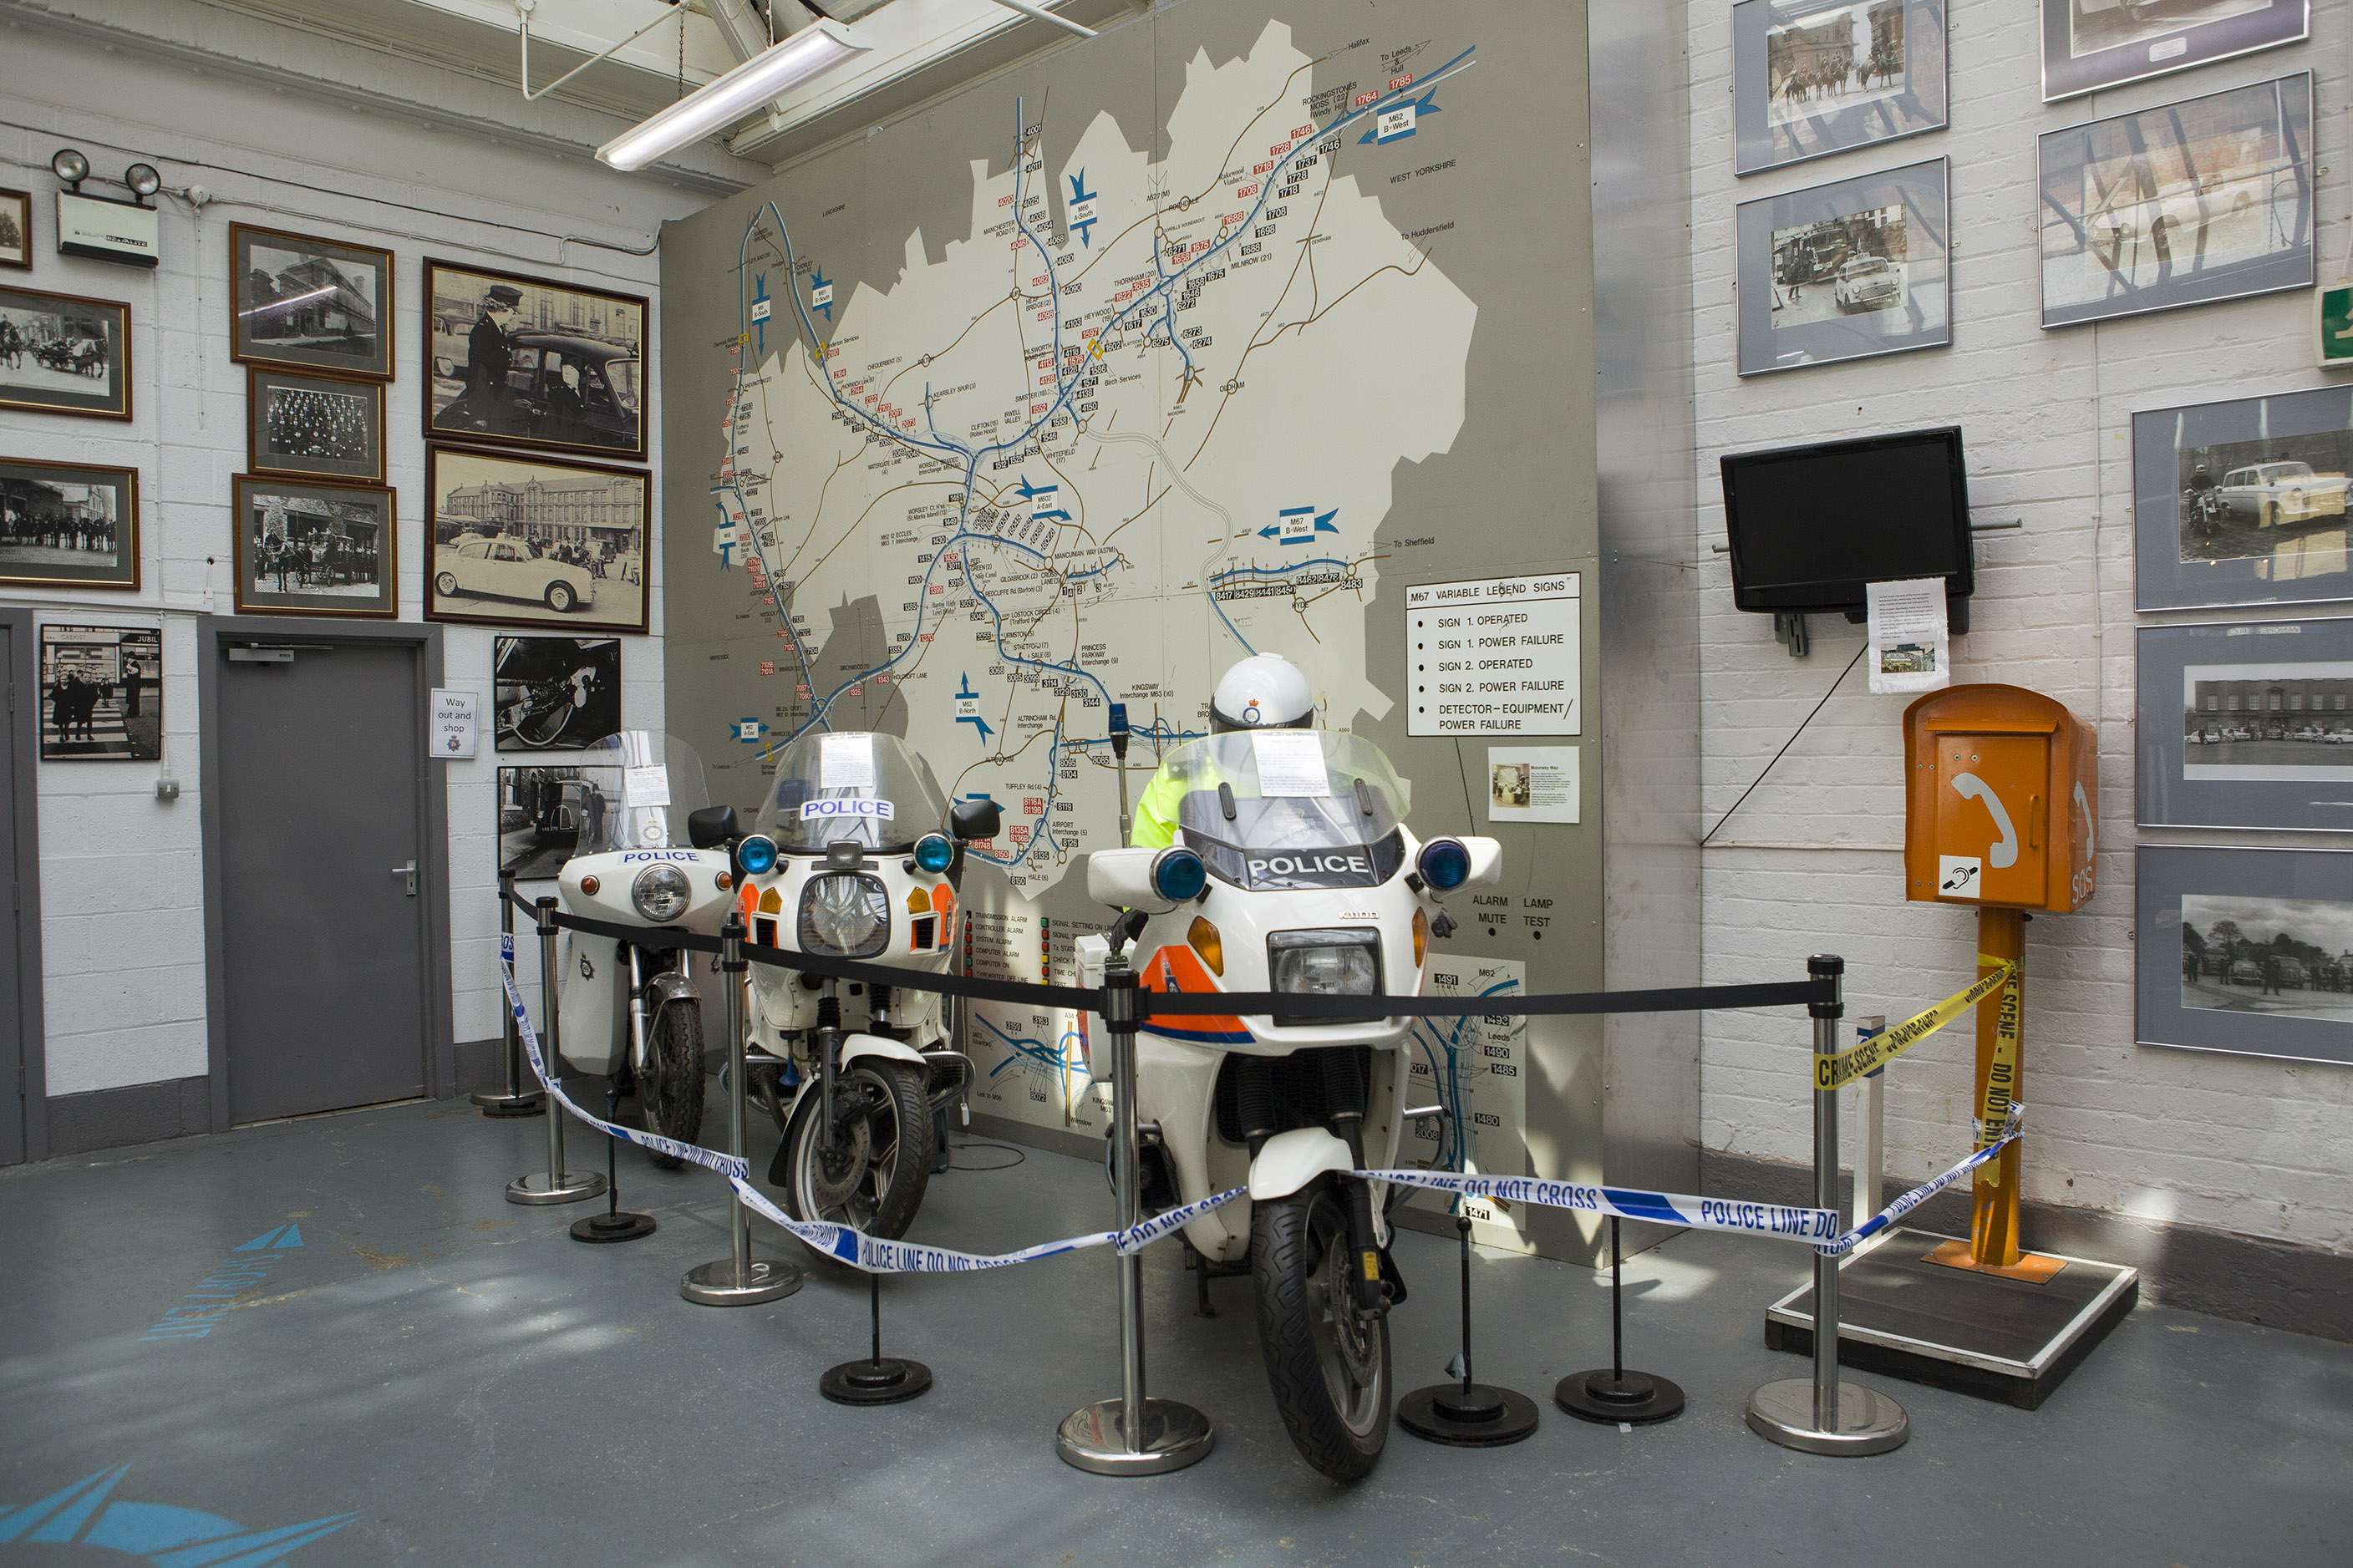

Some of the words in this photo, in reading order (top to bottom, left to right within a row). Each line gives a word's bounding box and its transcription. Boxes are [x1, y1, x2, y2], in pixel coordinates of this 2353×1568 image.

[1348, 38, 1370, 50] Halifax
[1392, 46, 1411, 58] Leeds
[1391, 65, 1404, 74] Hull
[1303, 82, 1357, 106] ROCKINGSTONES
[1357, 92, 1377, 104] 1764
[1310, 99, 1331, 111] MOSS
[1334, 93, 1349, 104] (22)
[1310, 107, 1332, 119] (Windy
[1389, 114, 1403, 124] M62
[1026, 124, 1041, 135] 4001
[1320, 141, 1339, 153] 1746
[1297, 157, 1316, 169] 1737
[1390, 174, 1410, 184] WEST
[1415, 160, 1456, 177] YORKSHIRE
[1078, 204, 1089, 212] M66
[1074, 211, 1093, 221] A-South
[1037, 221, 1053, 232] 4054
[1256, 226, 1275, 237] 1698
[1410, 221, 1454, 238] Huddersfield
[1192, 241, 1210, 251] 1675
[1231, 257, 1259, 269] MILNROW
[1261, 253, 1272, 262] (21)
[1114, 273, 1145, 287] THORNHAM
[1145, 270, 1156, 280] (20)
[1085, 308, 1111, 320] HEYWOOD
[1082, 329, 1098, 338] 1597
[1183, 327, 1202, 337] 6273
[1105, 378, 1117, 386] Birch
[1119, 374, 1141, 384] Services
[933, 388, 956, 398] KEARSLEY
[957, 385, 968, 394] SPUR
[1220, 382, 1245, 393] OLDHAM
[994, 461, 1008, 470] 1512
[1036, 501, 1053, 510] A-East
[1286, 525, 1309, 534] B-West
[1405, 537, 1435, 546] Sheffield
[1055, 551, 1084, 560] MANCUNIAN
[1097, 546, 1116, 555] (A57M)
[1341, 580, 1362, 589] 8483
[1217, 591, 1232, 600] 8417
[1410, 592, 1429, 601] M67
[1436, 588, 1479, 600] VARIABLE
[1487, 584, 1527, 596] LEGEND
[1533, 581, 1565, 592] SIGNS
[1438, 618, 1461, 627] SIGN
[1468, 617, 1473, 626] 1.
[1477, 614, 1528, 625] OPERATED
[1439, 640, 1461, 649] SIGN
[1468, 638, 1474, 647] 1.
[1479, 637, 1516, 647] POWER
[1521, 634, 1564, 646] FAILURE
[1439, 662, 1461, 671] SIGN
[1466, 661, 1474, 670] 2.
[1479, 659, 1533, 670] OPERATED
[1439, 683, 1461, 693] SIGN
[1466, 683, 1474, 692] 2.
[1479, 682, 1517, 692] POWER
[1522, 680, 1564, 691] FAILURE
[445, 698, 465, 708] Way
[455, 712, 471, 720] and
[444, 723, 465, 733] shop
[1440, 720, 1476, 729] POWER
[1481, 720, 1522, 729] FAILURE
[1062, 770, 1077, 779] 8104
[805, 800, 890, 817] POLICE
[624, 851, 700, 863] POLICE
[1248, 855, 1370, 877] POLICE
[2072, 865, 2093, 905] SOS
[1473, 896, 1508, 906] ALARM
[1524, 898, 1553, 909] LAMP
[975, 912, 1009, 921] TRANSMISSION
[1339, 911, 1380, 920] K1100
[1478, 913, 1507, 924] MUTE
[1072, 921, 1093, 930] SETTING
[1524, 916, 1551, 927] TEST
[975, 923, 1005, 932] CONTROLLER
[976, 947, 1001, 956] COMPUTER
[976, 959, 1001, 967] COMPUTER
[977, 972, 1005, 982] TYPEWRITER
[1437, 975, 1457, 984] 1491
[1998, 994, 2018, 1039] SCENE
[1486, 1048, 1509, 1058] 1490
[1818, 1051, 1853, 1086] CRIME
[1852, 1041, 1880, 1074] SCENE
[1990, 1063, 2012, 1083] DO
[1986, 1087, 2010, 1114] NOT
[1476, 1114, 1499, 1125] 1480
[641, 1135, 670, 1153] POLICE
[714, 1155, 749, 1179] CROSS
[1464, 1179, 1489, 1196] DO
[1495, 1180, 1532, 1201] NOT
[1537, 1183, 1598, 1210] CROSS
[1467, 1208, 1489, 1220] 1471
[1700, 1200, 1765, 1231] POLICE
[1770, 1207, 1810, 1236] LINE
[1813, 1212, 1837, 1240] DO
[896, 1246, 923, 1271] LINE
